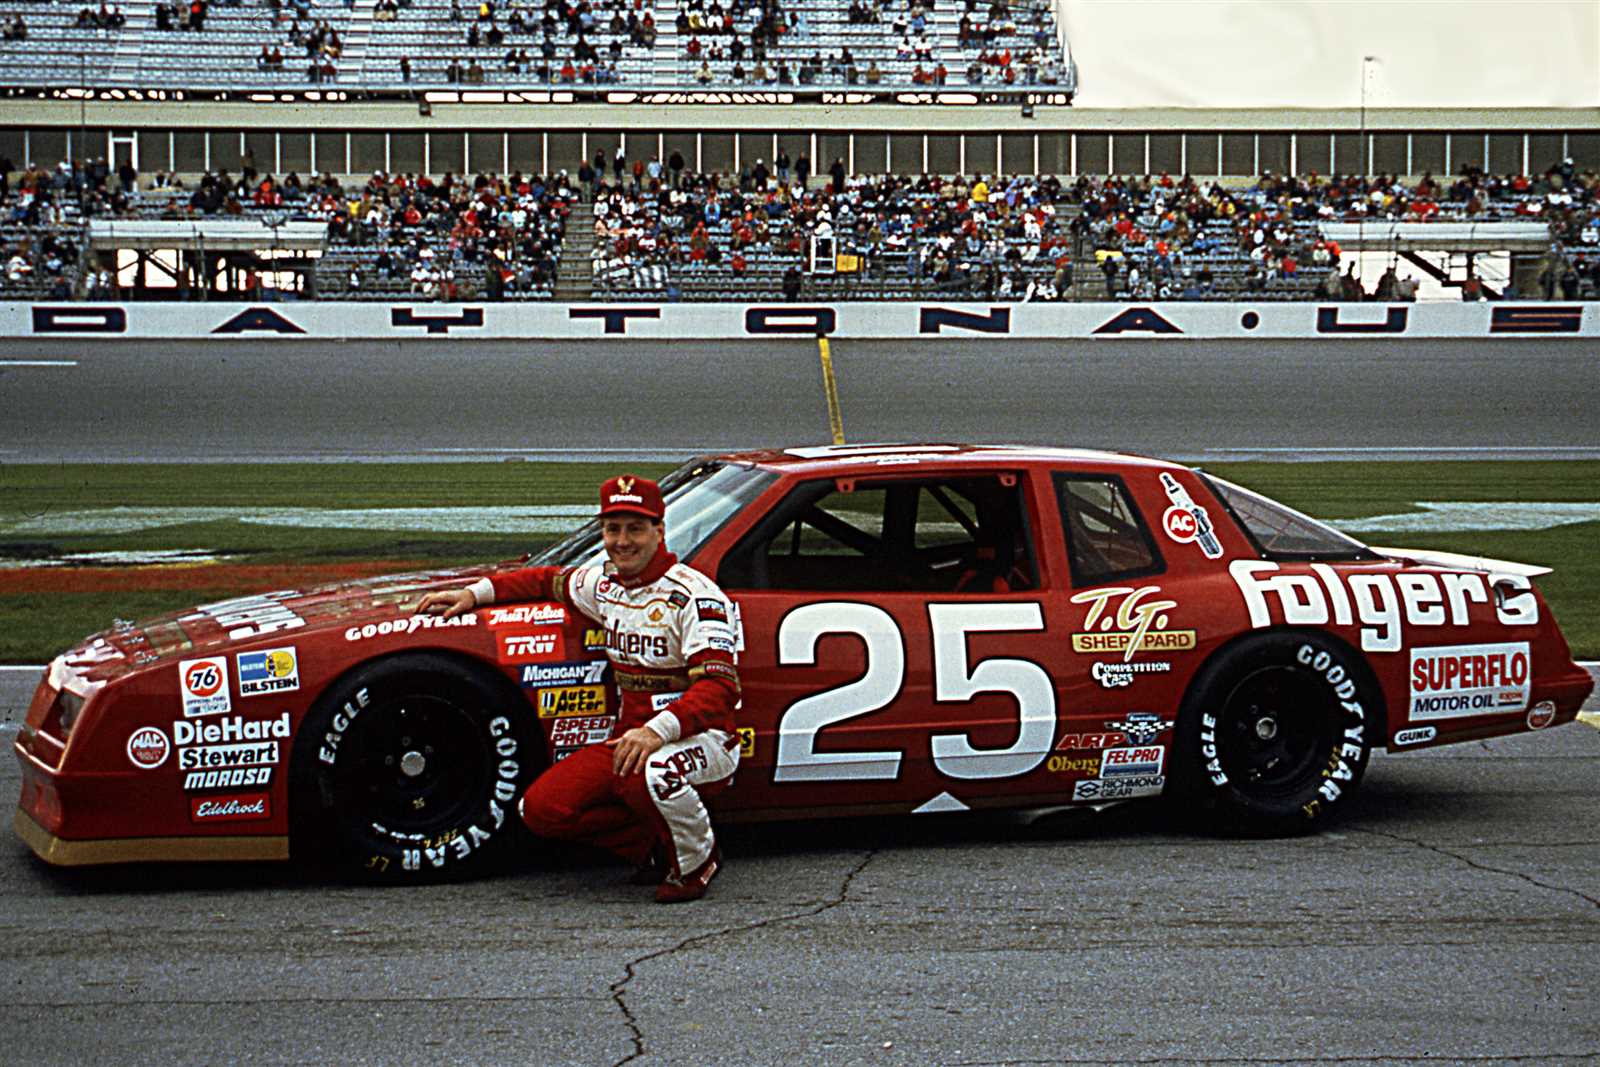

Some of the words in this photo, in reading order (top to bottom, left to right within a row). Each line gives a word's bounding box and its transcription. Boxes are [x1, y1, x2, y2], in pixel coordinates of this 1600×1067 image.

[32, 306, 1185, 335] DAYTONA
[1170, 514, 1194, 532] AC
[1229, 560, 1540, 652] Folgers
[345, 612, 478, 641] GOODYEAR
[504, 634, 557, 656] TRW
[1080, 632, 1190, 650] SHEPPARD
[190, 666, 217, 690] 76
[523, 664, 585, 682] MICHIGAN
[1412, 652, 1528, 692] SUPERFLO
[242, 677, 298, 694] BILSTEIN
[559, 687, 597, 701] Auto
[774, 602, 1057, 780] 25
[1414, 696, 1468, 713] MOTOR
[1472, 694, 1495, 709] OIL
[173, 712, 291, 746] DieHard
[319, 687, 371, 765] EAGLE
[554, 718, 611, 733] SPEED
[1296, 644, 1365, 802] GOODYEAR
[553, 731, 590, 745] PRO
[1055, 732, 1127, 751] ARP
[1399, 730, 1432, 742] GUNK
[182, 743, 276, 768] Stewart
[1106, 748, 1161, 764] FEL-PRO
[1200, 713, 1229, 787] EAGLE
[1047, 755, 1100, 775] Oberg
[1101, 787, 1134, 798] GEAR
[1102, 777, 1164, 789] RICHMOND
[402, 716, 520, 871] GOODYEAR
[196, 799, 265, 817] Edelbrock
